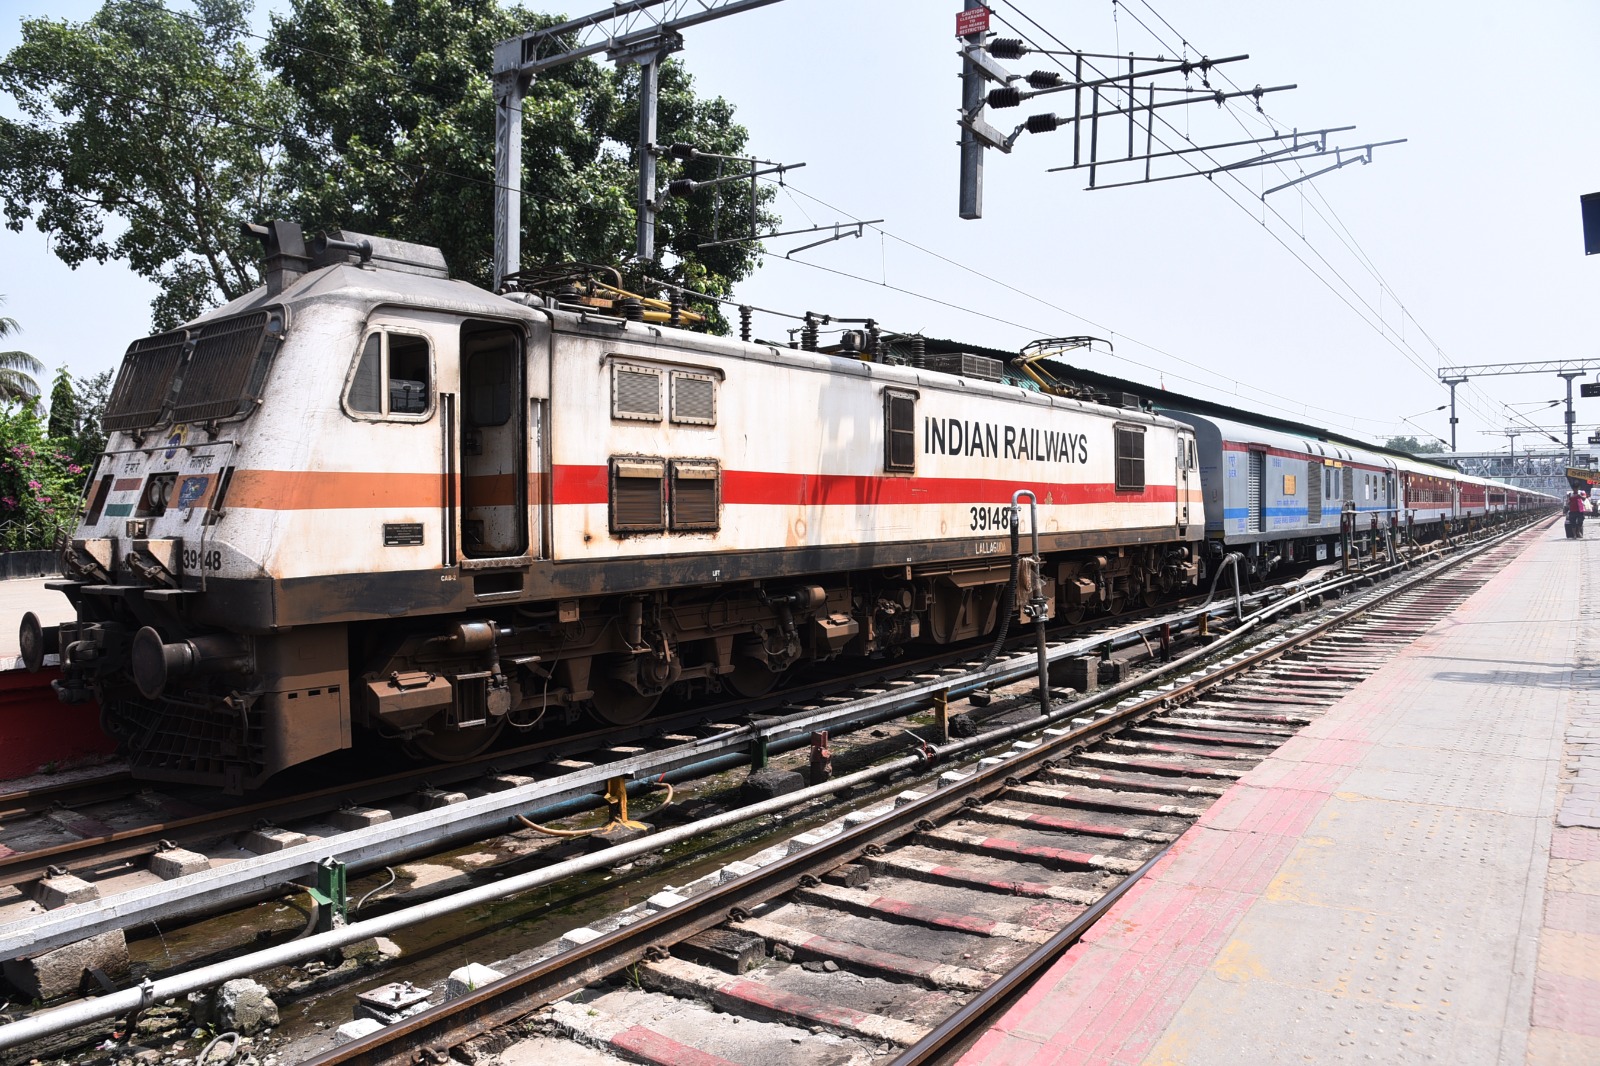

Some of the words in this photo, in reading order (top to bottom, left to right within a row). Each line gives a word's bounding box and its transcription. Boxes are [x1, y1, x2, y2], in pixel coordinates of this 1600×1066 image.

[960, 13, 985, 21] CLEARANCE
[961, 8, 983, 17] CAUTION
[960, 26, 985, 34] RESTRICTED
[925, 416, 998, 458] INDIAN
[1004, 425, 1088, 465] RAILWAYS
[970, 506, 1009, 531] 39148
[975, 541, 1006, 555] LALLAGUDA
[183, 549, 222, 571] 39148
